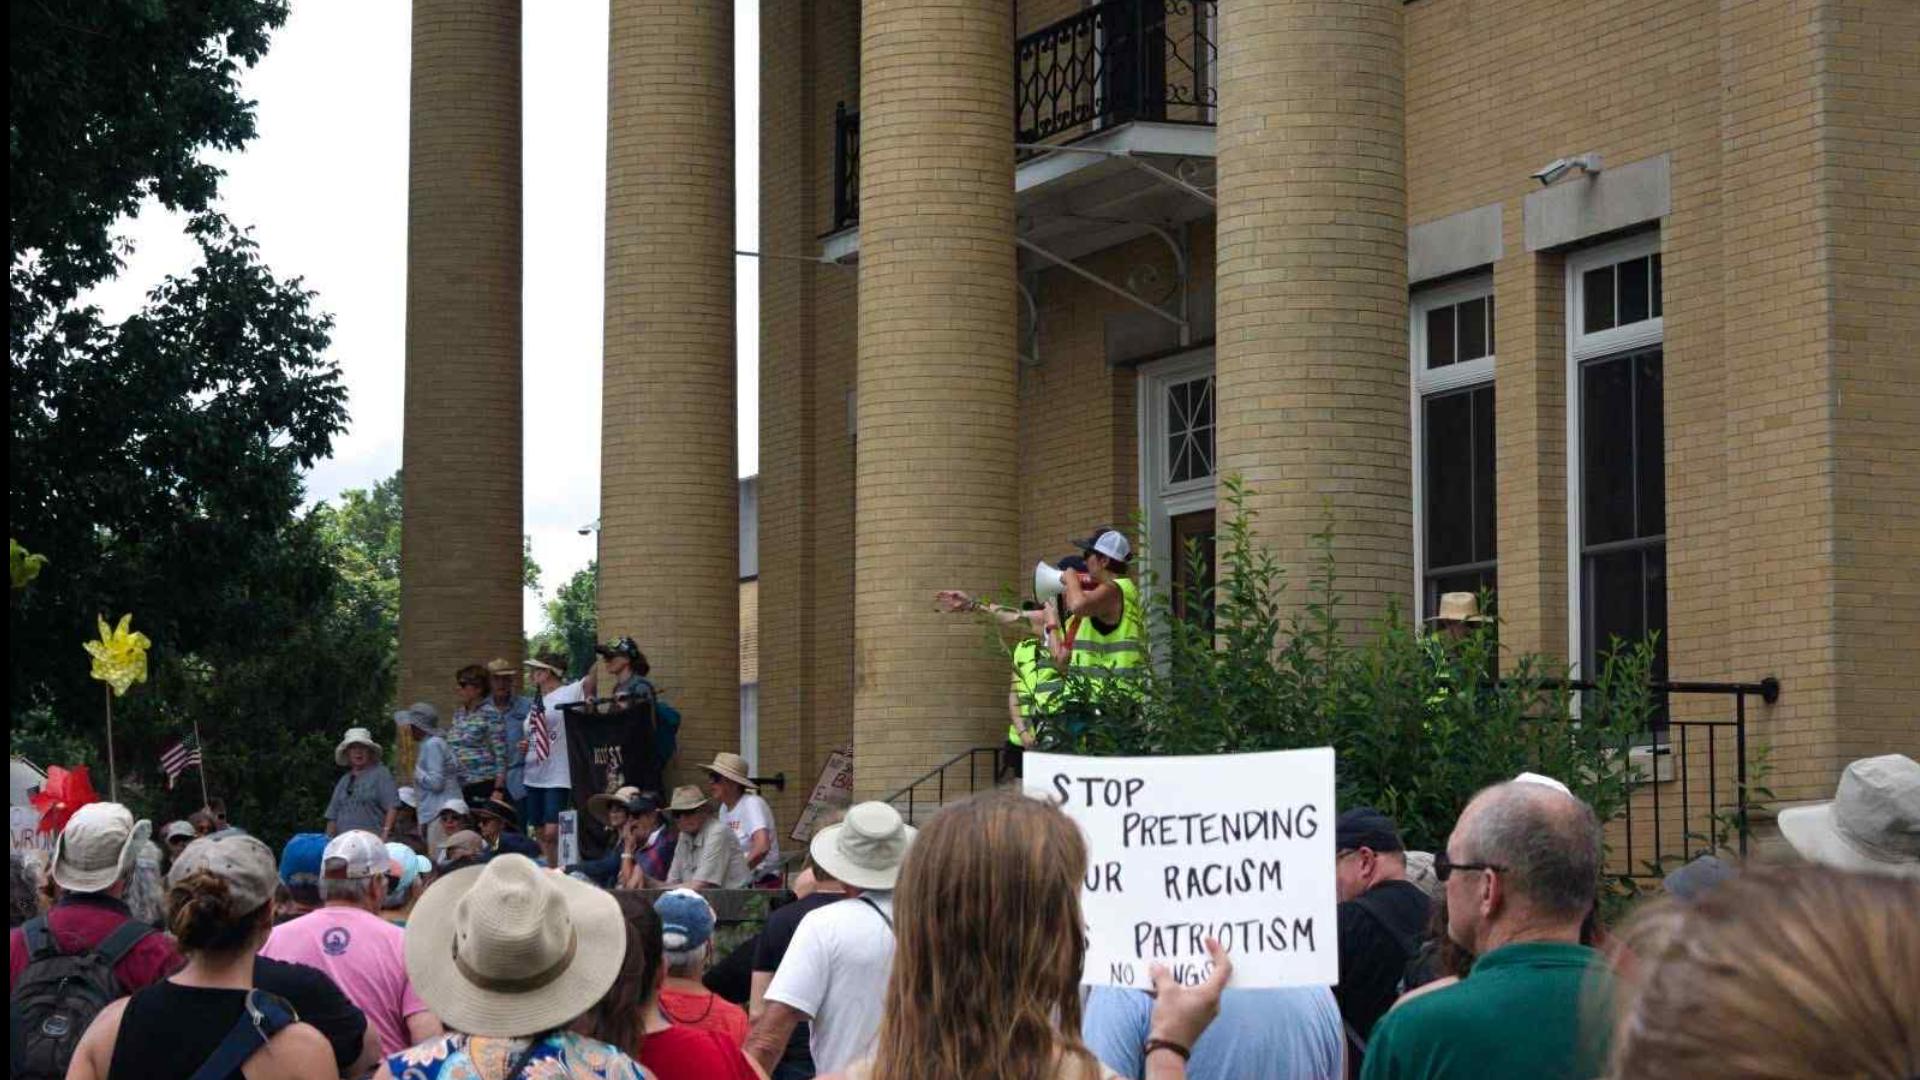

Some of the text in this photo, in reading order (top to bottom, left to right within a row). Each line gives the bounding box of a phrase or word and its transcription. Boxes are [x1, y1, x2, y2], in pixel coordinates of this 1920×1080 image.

[1052, 773, 1145, 807] STOP
[1122, 804, 1318, 848] PRETENDING
[1084, 858, 1283, 901] UR RACISM
[1110, 961, 1135, 986] NO
